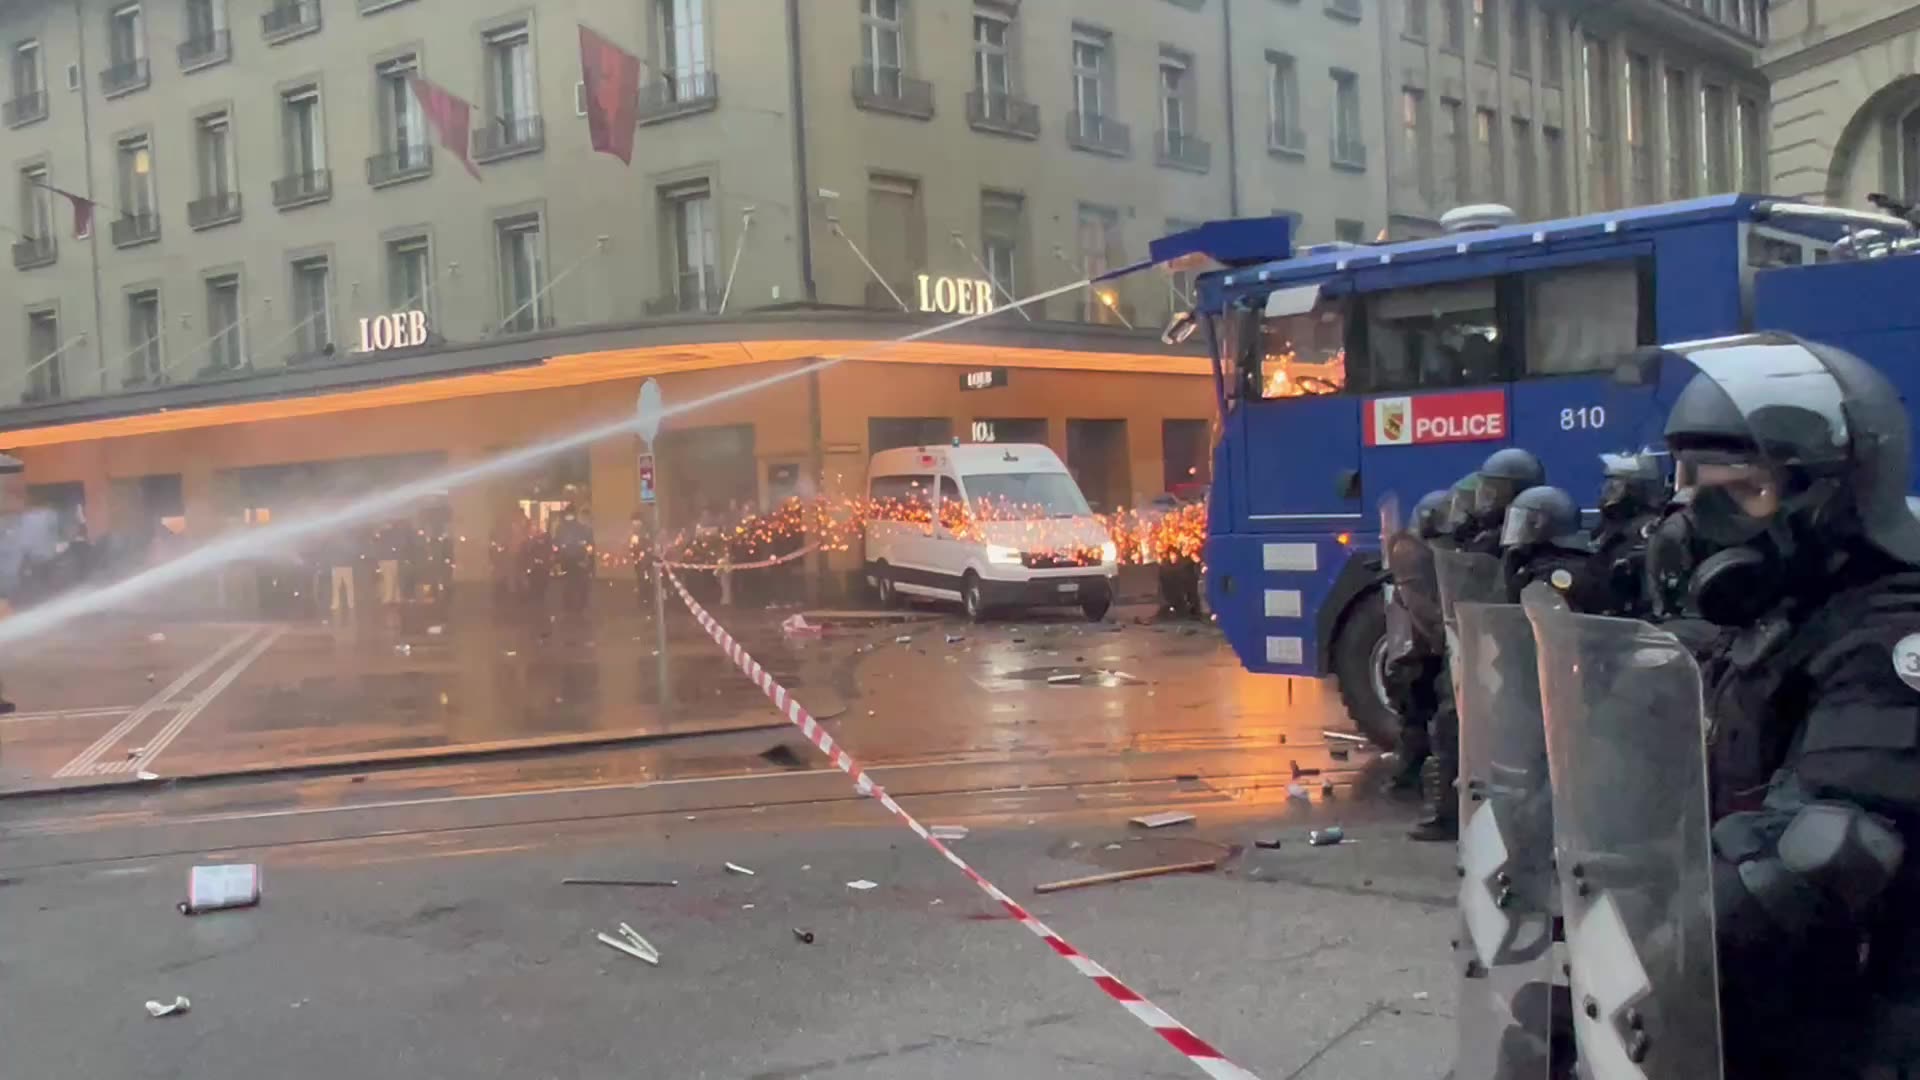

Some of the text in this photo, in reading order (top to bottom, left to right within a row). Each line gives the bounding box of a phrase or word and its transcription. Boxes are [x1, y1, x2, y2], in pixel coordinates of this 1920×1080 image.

[359, 310, 427, 353] LOEB
[1416, 413, 1502, 438] POLICE
[1560, 406, 1605, 430] 810
